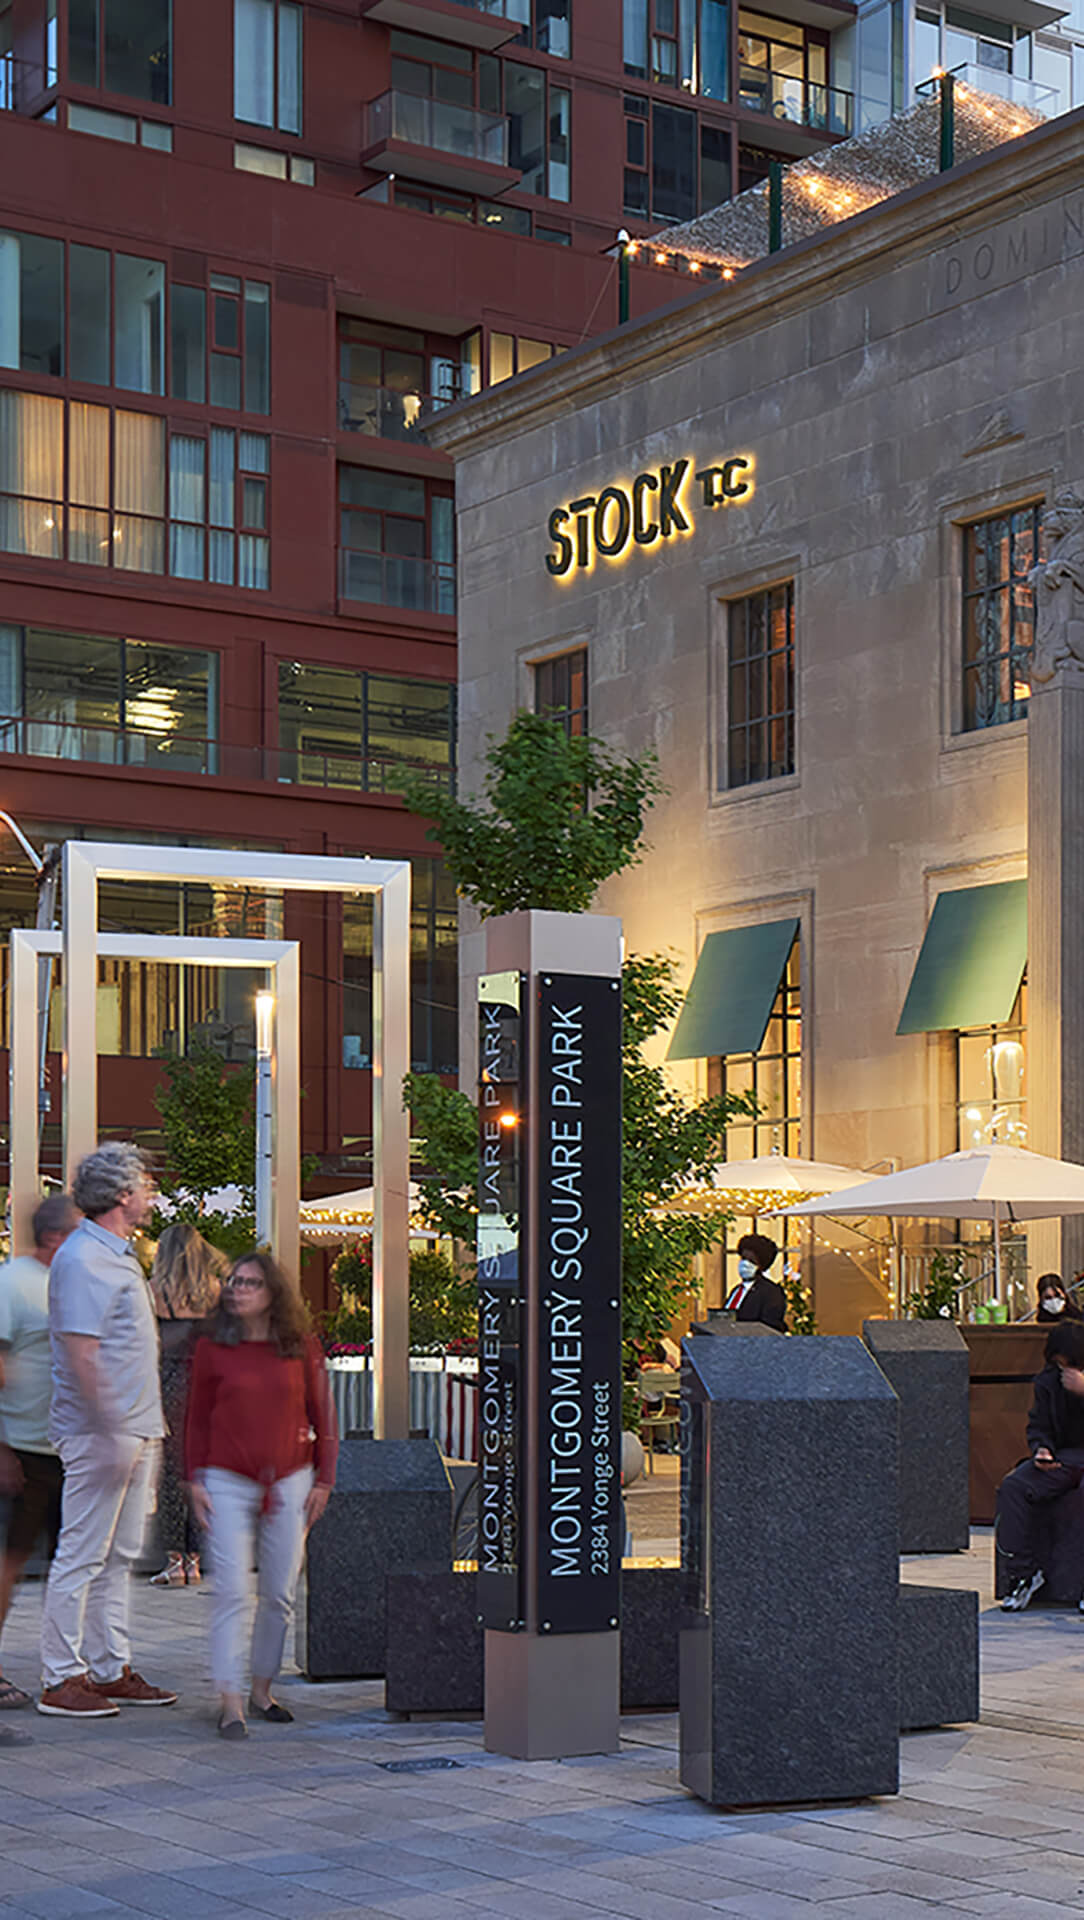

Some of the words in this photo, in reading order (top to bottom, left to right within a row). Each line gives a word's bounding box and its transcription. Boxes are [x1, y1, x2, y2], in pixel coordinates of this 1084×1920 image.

[946, 197, 1084, 295] DOMIN
[545, 459, 689, 576] STOCK
[484, 1005, 501, 1107] PARK
[551, 1004, 583, 1107] PARK
[483, 1120, 503, 1279] SUARE
[551, 1120, 589, 1281] SQUARE
[483, 1289, 501, 1574] MONTGOMERY
[551, 1289, 582, 1577] MONTGOMERY
[591, 1381, 609, 1448] Street
[591, 1452, 614, 1519] Yonge
[591, 1525, 609, 1575] 2384
